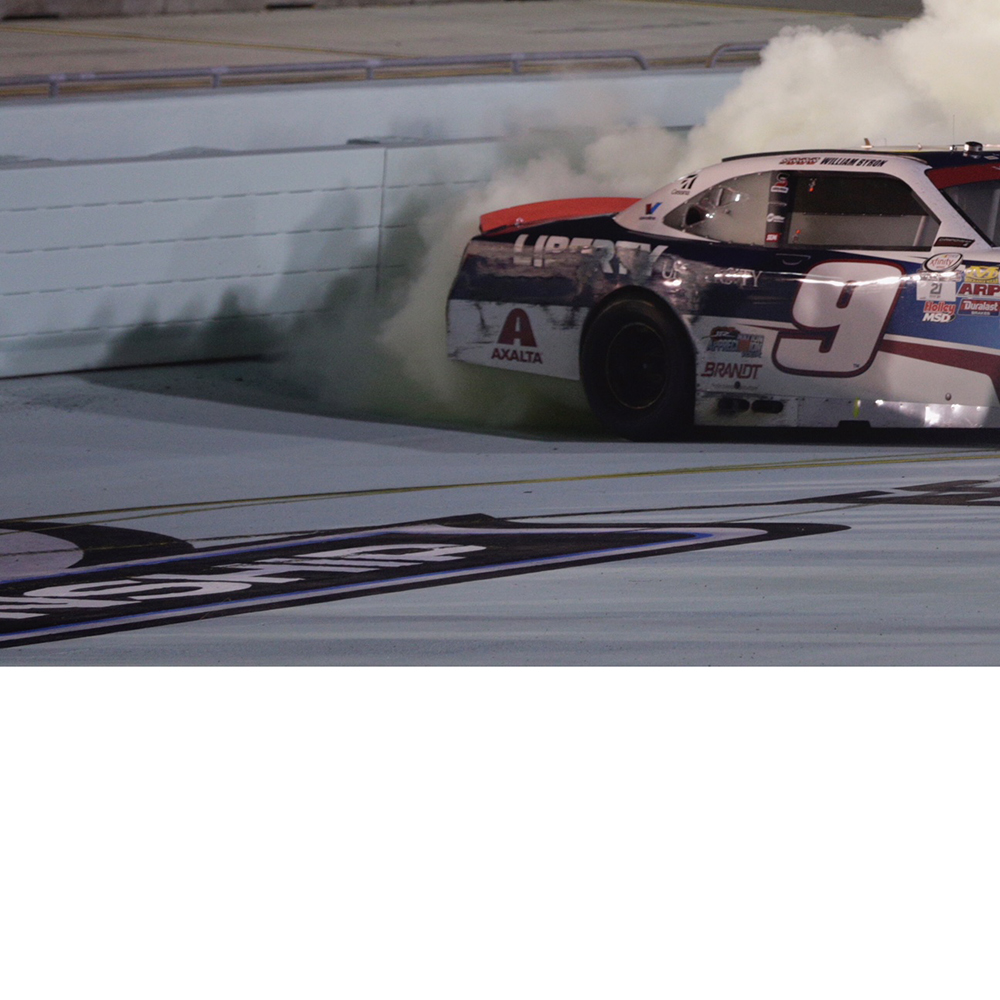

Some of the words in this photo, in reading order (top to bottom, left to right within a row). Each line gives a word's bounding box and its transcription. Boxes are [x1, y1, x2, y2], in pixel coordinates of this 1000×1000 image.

[820, 157, 859, 166] WILLIAM
[856, 158, 888, 167] BYRON
[959, 284, 1000, 296] ARP
[923, 301, 956, 316] Holley
[963, 300, 999, 311] Duralast
[771, 258, 905, 378] 9
[922, 313, 951, 322] MSD
[491, 348, 543, 364] AXALTA
[700, 361, 763, 380] BRANDT
